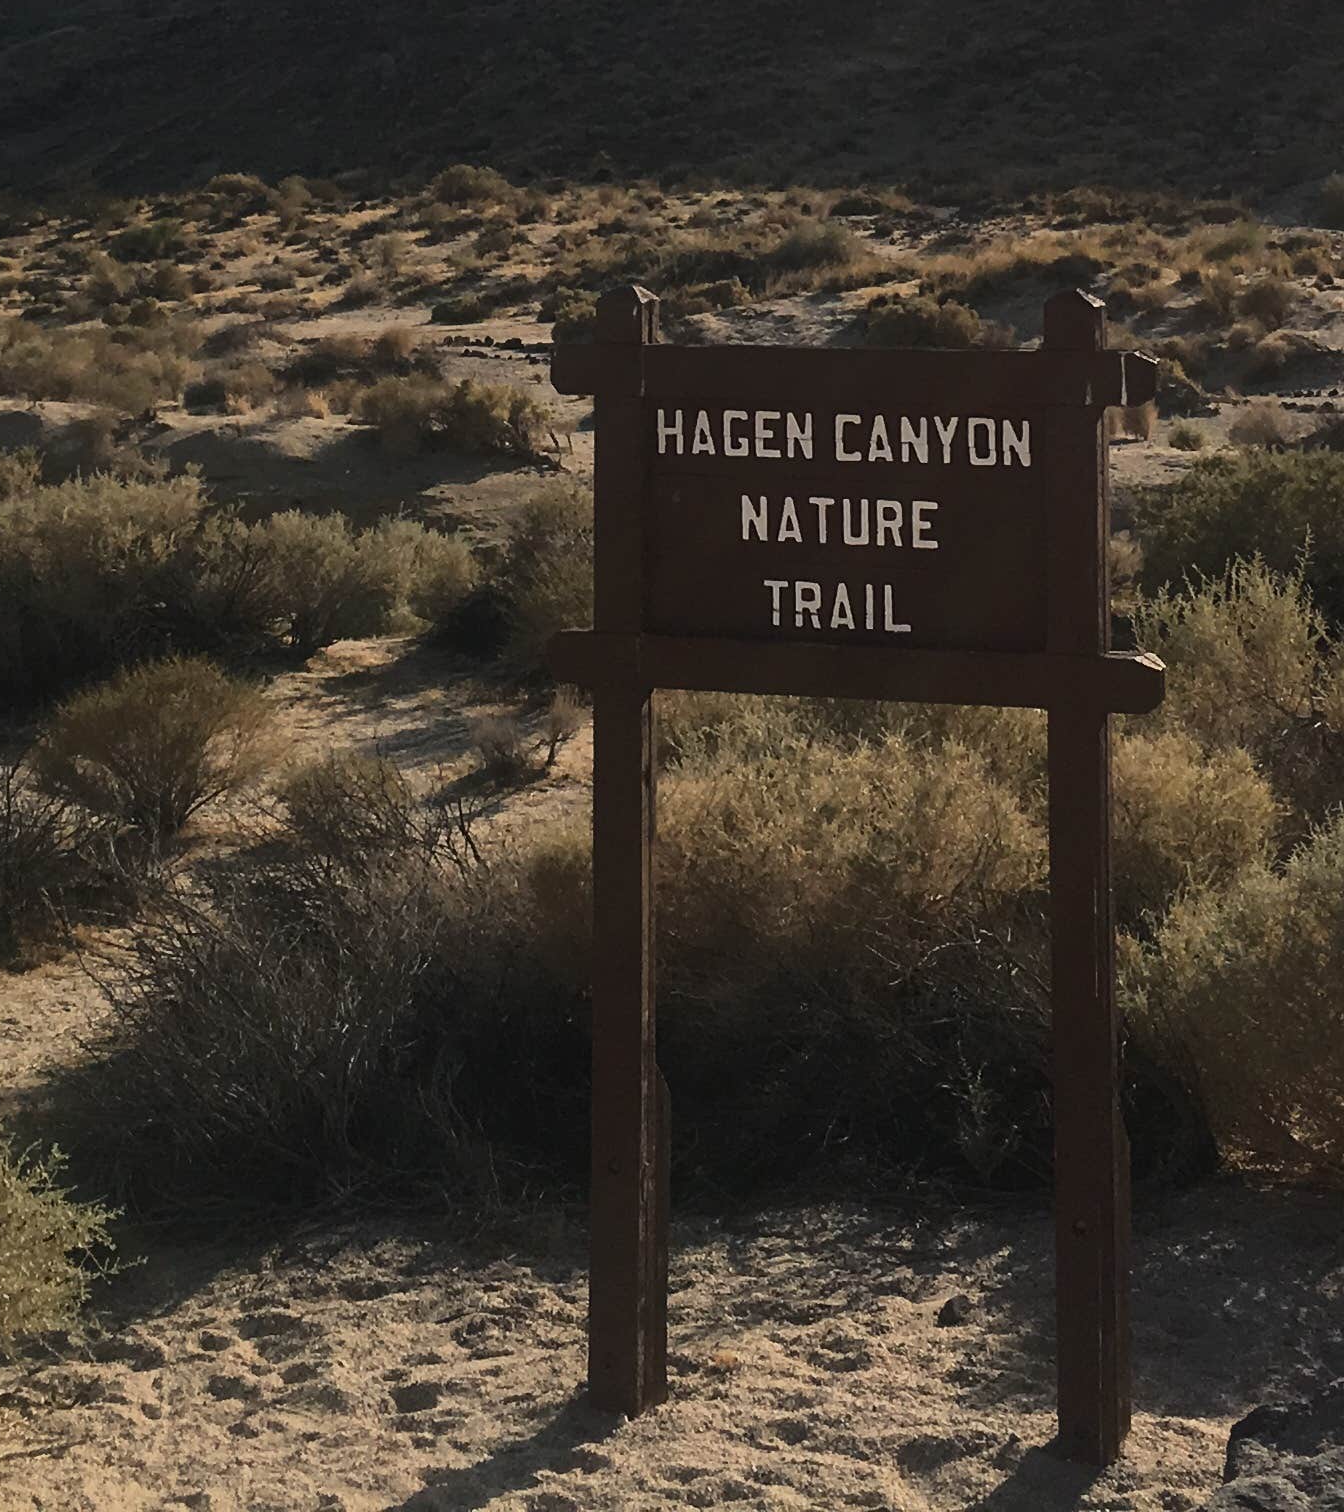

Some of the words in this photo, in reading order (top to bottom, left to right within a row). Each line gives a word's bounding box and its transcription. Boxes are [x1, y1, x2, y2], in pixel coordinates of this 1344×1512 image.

[657, 409, 813, 460] HAGEN
[835, 414, 1031, 467] CANYON
[742, 495, 939, 549] NATURE
[764, 580, 912, 632] TRAIL
